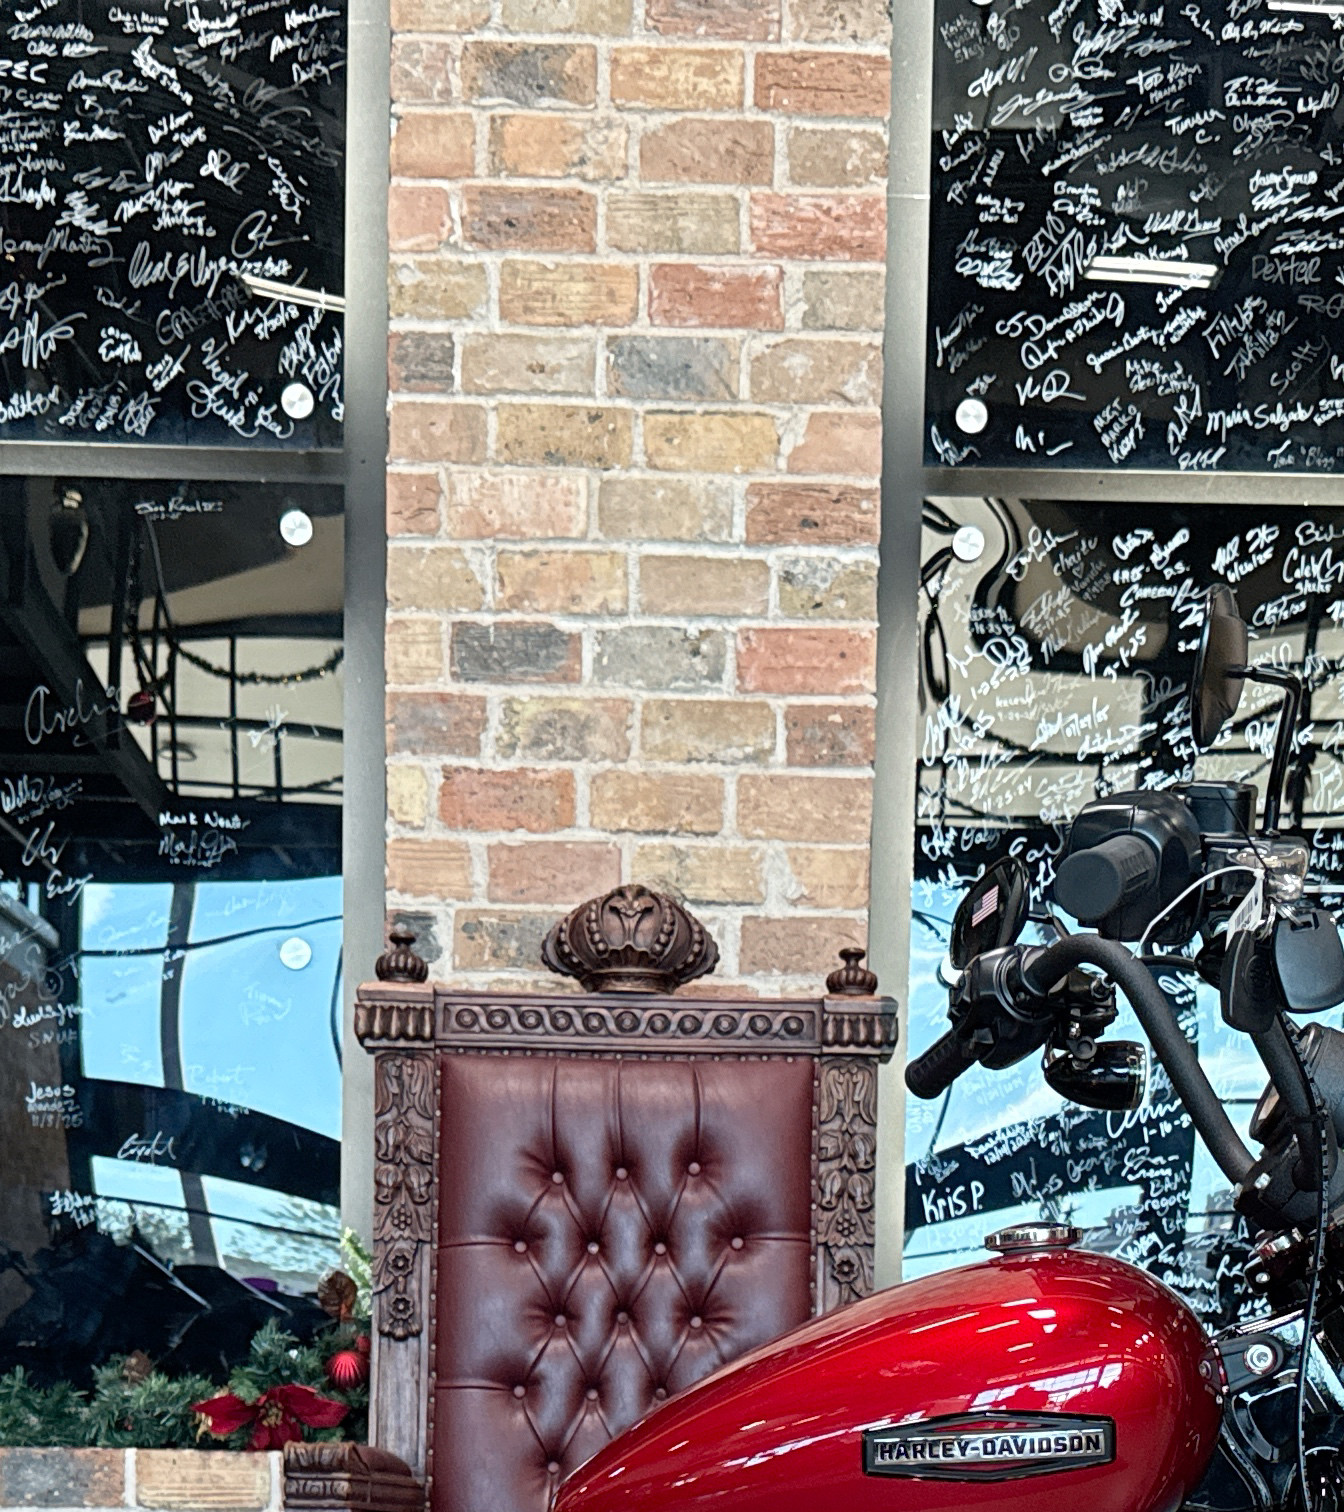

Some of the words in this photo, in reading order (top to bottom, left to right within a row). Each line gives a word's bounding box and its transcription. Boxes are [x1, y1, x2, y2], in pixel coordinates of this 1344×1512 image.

[26, 1081, 76, 1103] Jesus
[922, 1185, 967, 1223] Kris
[879, 1434, 1102, 1461] HARLEY-DAVIDSON
